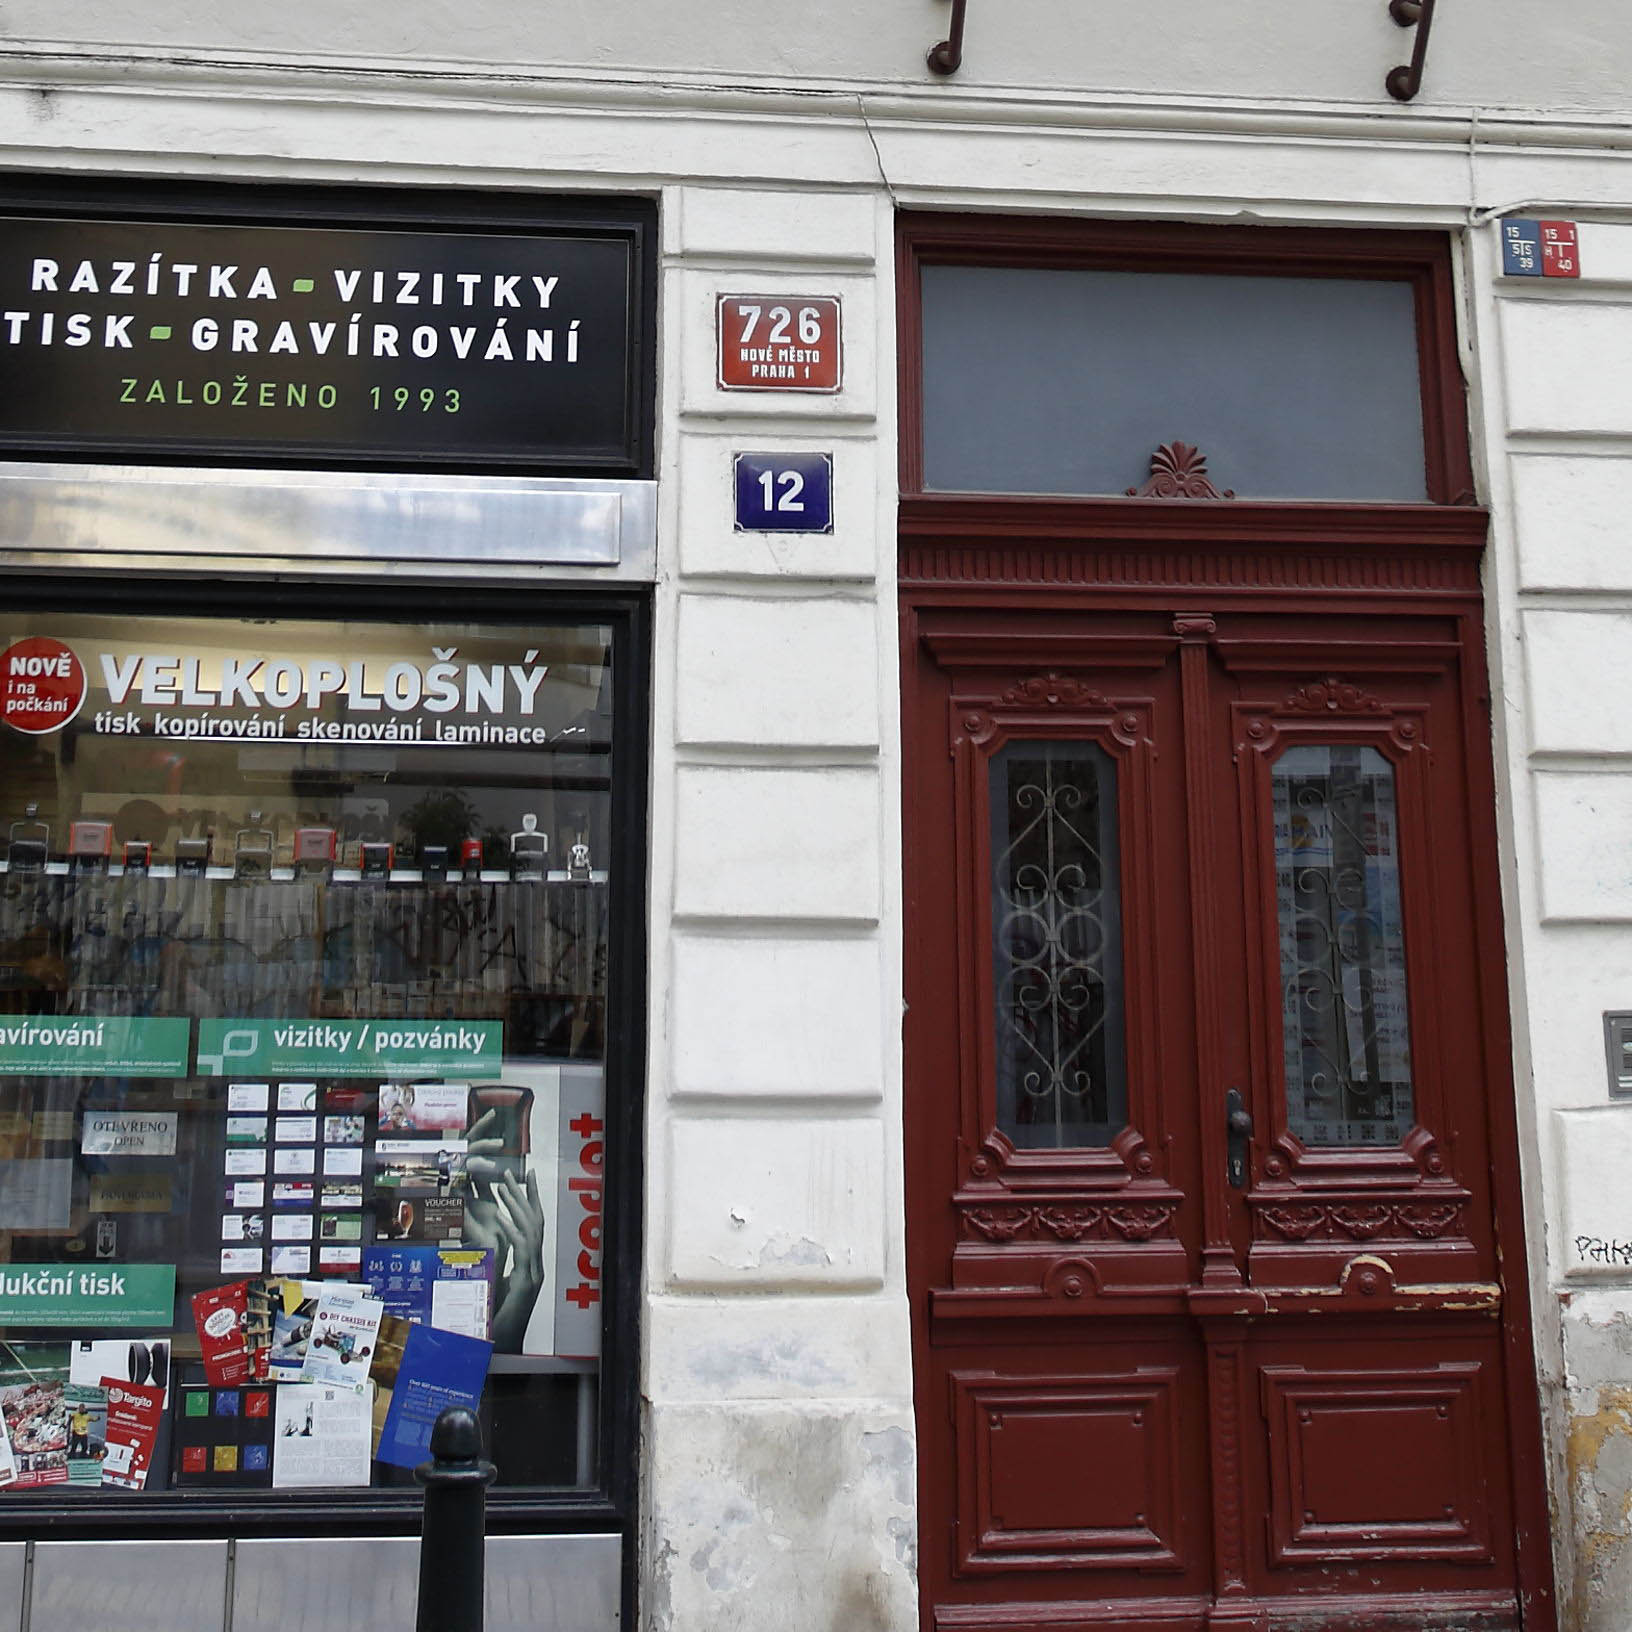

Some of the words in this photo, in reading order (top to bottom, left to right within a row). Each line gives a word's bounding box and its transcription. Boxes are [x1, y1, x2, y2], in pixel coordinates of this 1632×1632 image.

[31, 252, 277, 300] RAZÍTKA
[334, 270, 559, 308] VIZITKY
[4, 311, 134, 348] TISK
[192, 313, 581, 363] GRAVÍROVÁNÍ
[738, 305, 821, 344] 726
[740, 345, 773, 362] NOVÉ
[778, 345, 820, 364] MĚSTO
[752, 364, 795, 379] PRAHA
[803, 366, 810, 379] 1
[120, 375, 337, 409] ZALOŽENO
[370, 387, 461, 414] 1993
[758, 470, 805, 512] 12
[10, 652, 72, 679] NOVĚ
[99, 647, 549, 715] VELKOPLOŠNÝ
[6, 695, 68, 715] počkání
[17, 684, 36, 695] na
[95, 711, 141, 735] tisk
[154, 713, 285, 740] kopírování
[298, 716, 423, 741] skenování
[436, 720, 546, 745] laminace
[274, 1025, 352, 1053] vizitky
[375, 1027, 487, 1055] pozvánky
[114, 1135, 145, 1146] OPEN
[566, 1112, 603, 1310] trodat
[79, 1272, 126, 1296] tisk
